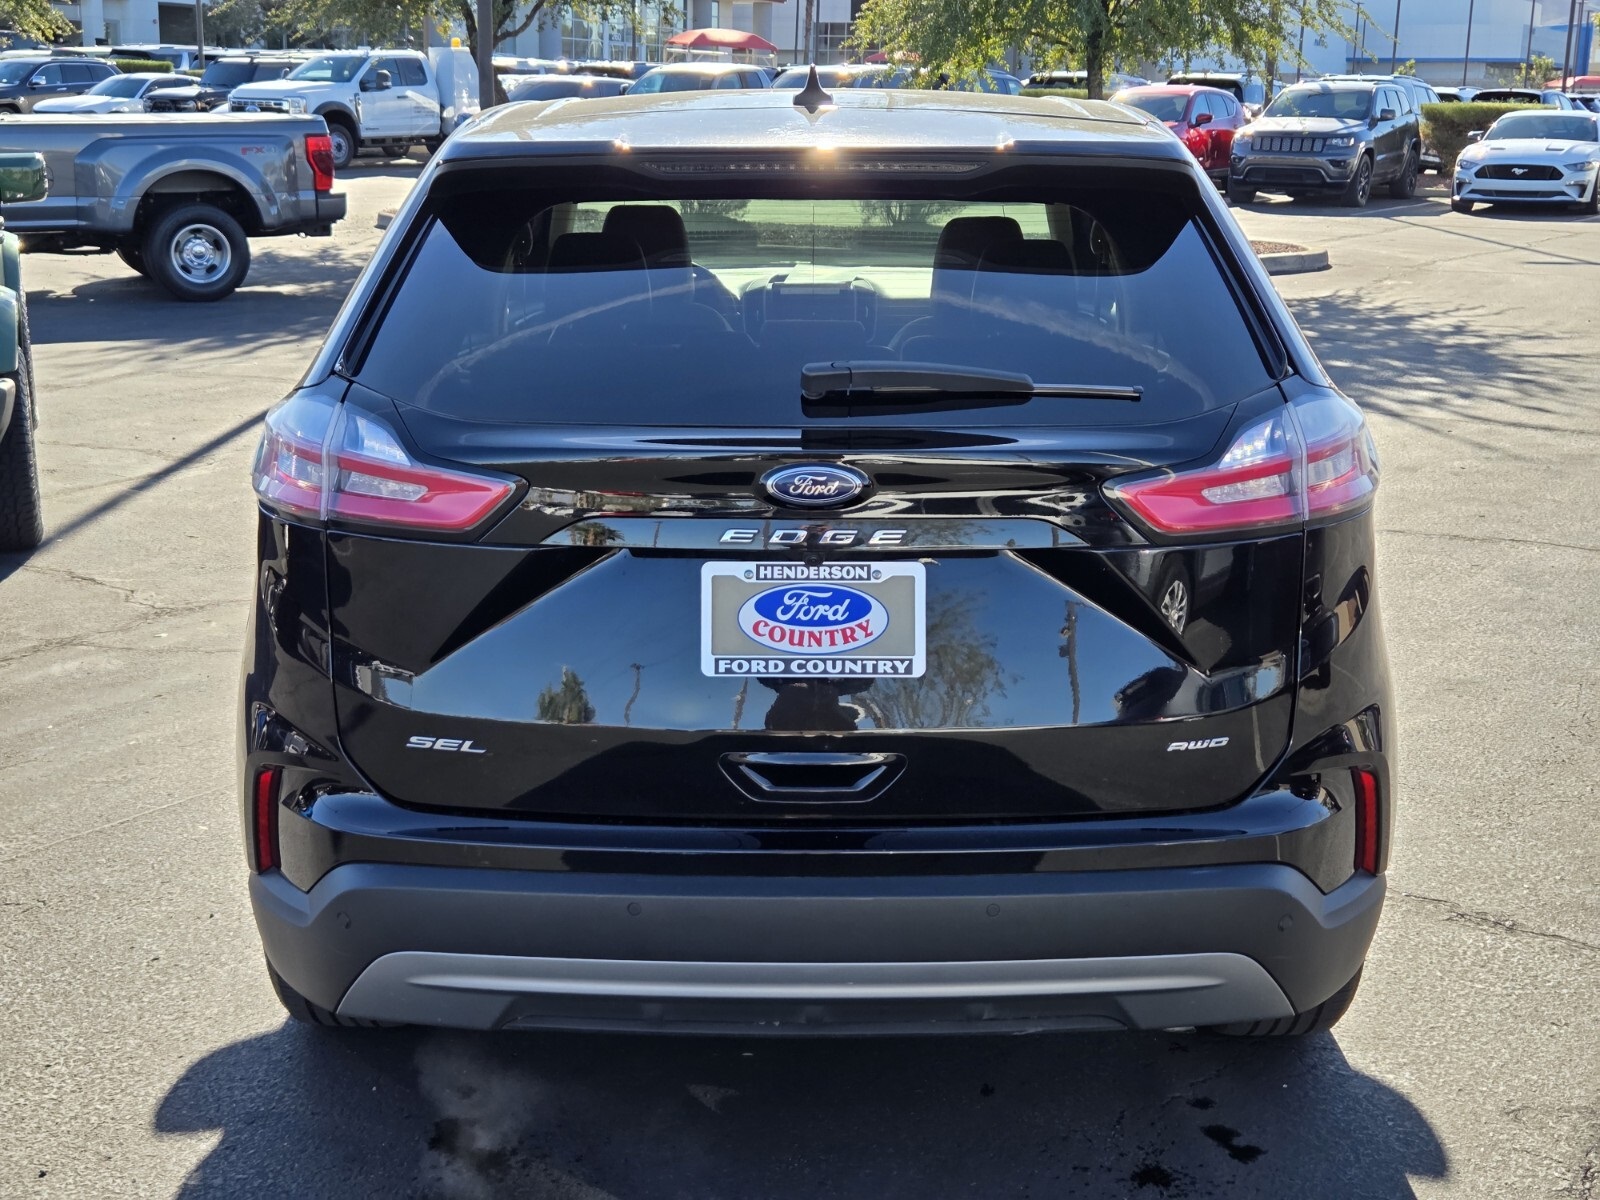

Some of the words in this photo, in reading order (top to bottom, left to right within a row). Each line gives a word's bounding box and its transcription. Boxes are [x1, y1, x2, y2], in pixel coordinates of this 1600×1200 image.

[789, 474, 839, 496] Ford
[719, 529, 907, 545] EDGE
[759, 566, 869, 580] HENDERSON
[776, 589, 851, 621] Ford
[752, 619, 874, 648] COUNTRY
[718, 659, 785, 674] FORD
[790, 659, 910, 674] COUNTRY
[406, 735, 487, 754] SEL
[1166, 736, 1230, 752] AWD
